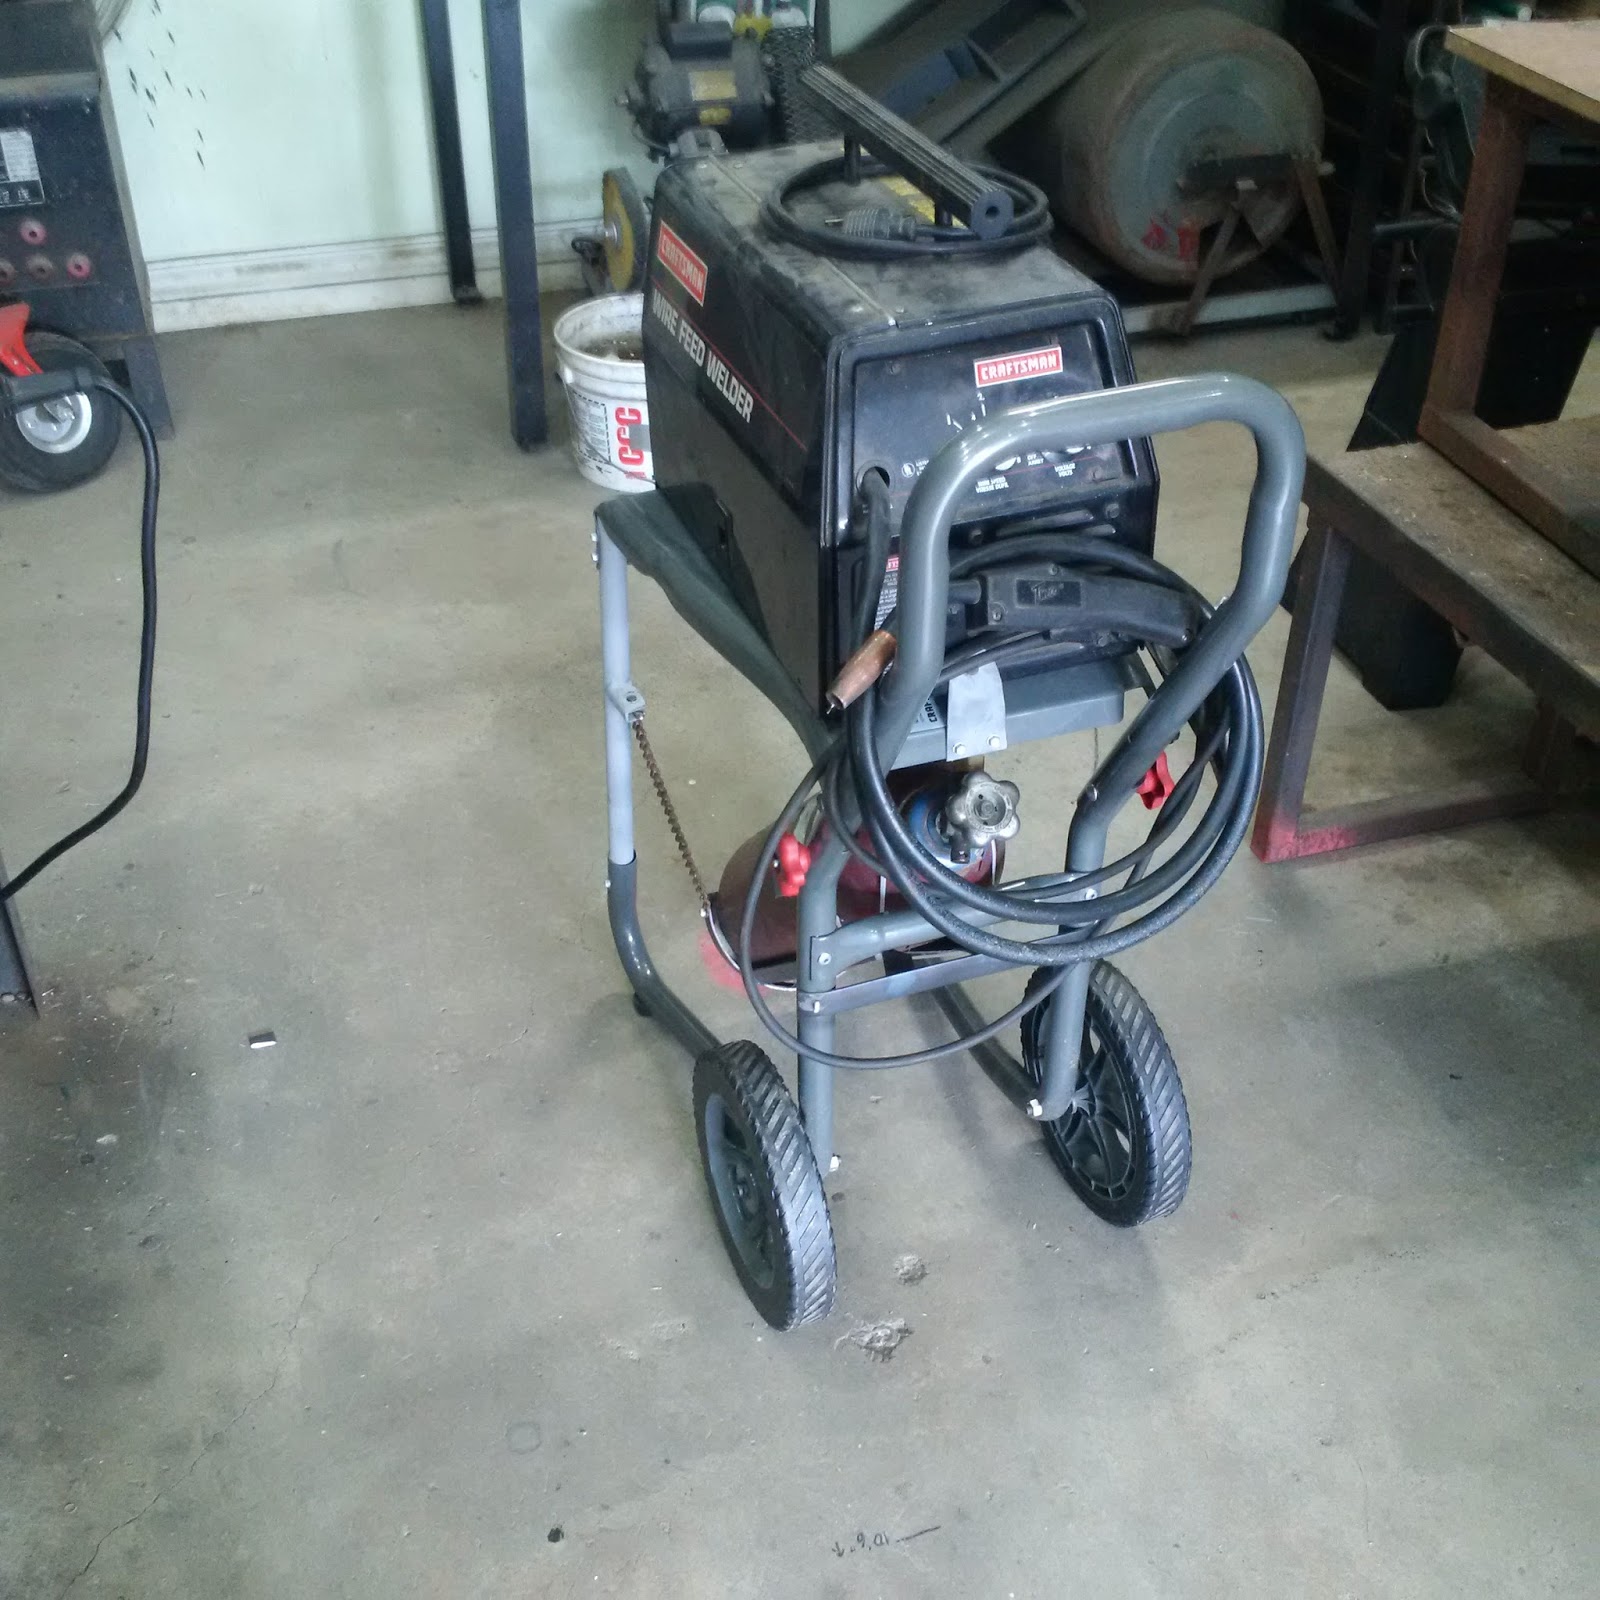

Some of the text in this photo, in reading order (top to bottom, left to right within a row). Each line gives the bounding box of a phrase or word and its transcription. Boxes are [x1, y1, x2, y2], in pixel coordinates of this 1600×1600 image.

[660, 233, 705, 296] CRAFTSMAN
[652, 288, 754, 423] WIRE FEED WELDER
[980, 353, 1057, 381] CRAFTSMAN
